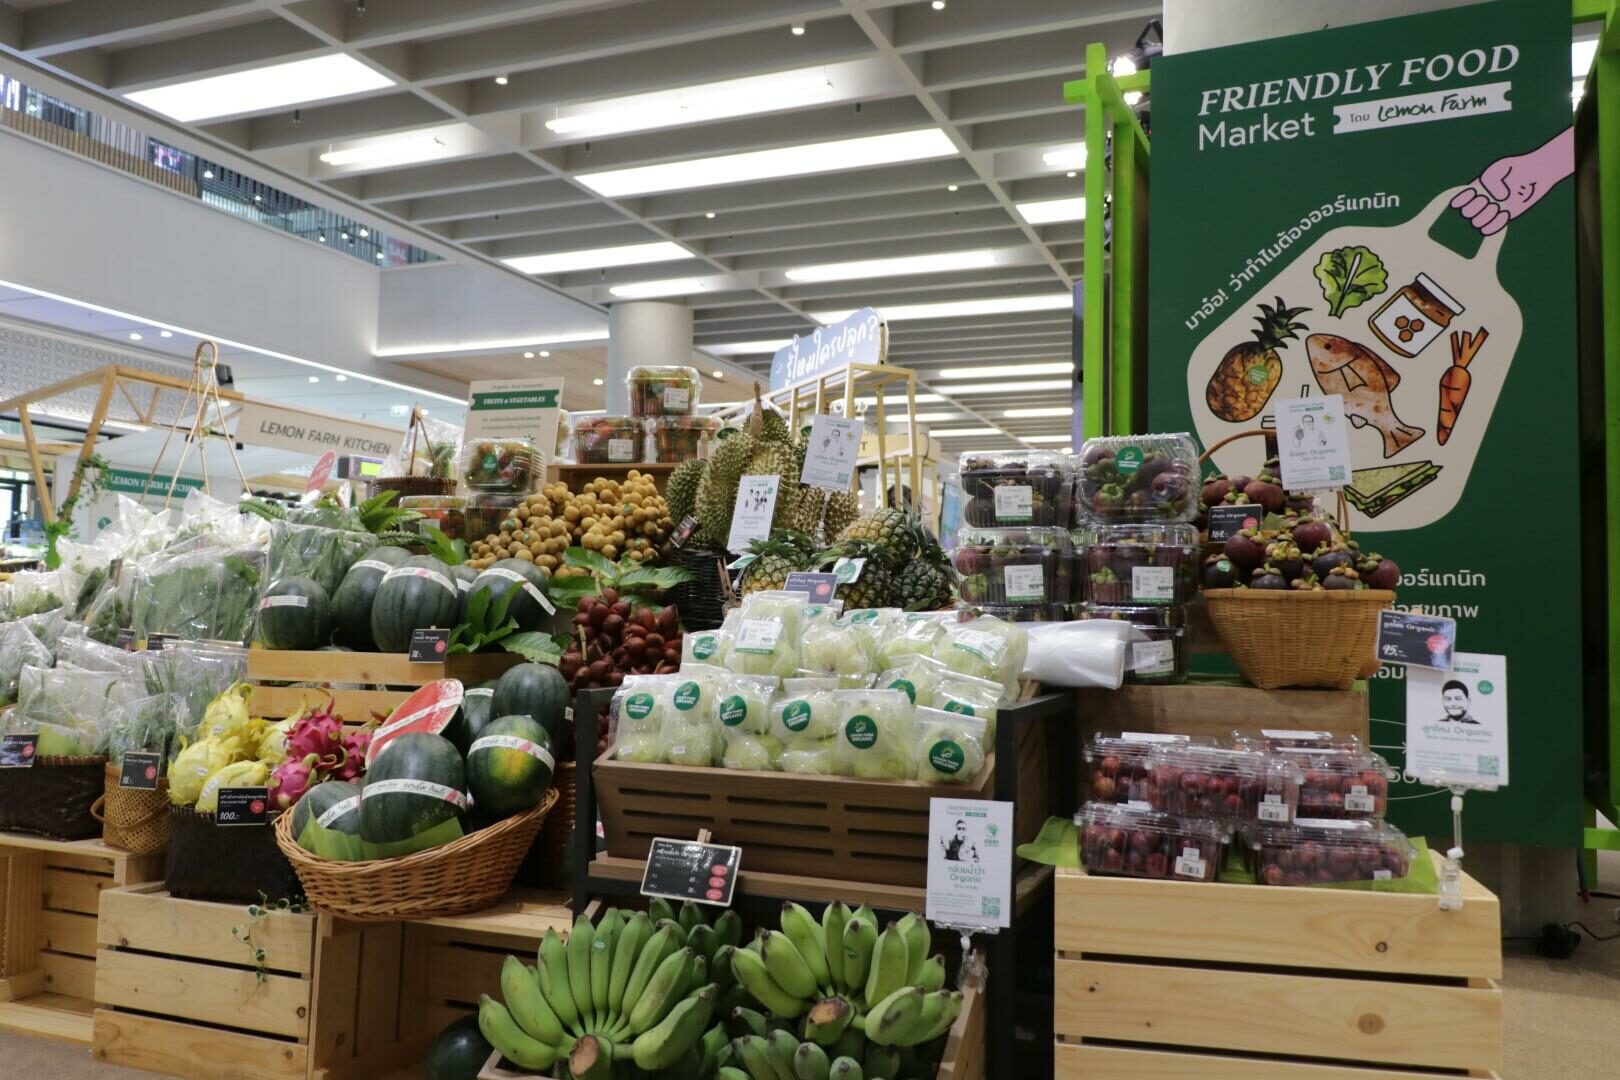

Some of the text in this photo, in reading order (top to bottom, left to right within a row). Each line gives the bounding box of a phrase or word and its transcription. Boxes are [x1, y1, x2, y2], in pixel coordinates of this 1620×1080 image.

[1198, 44, 1520, 116] FRIENDLY FOOD
[1350, 93, 1488, 124] โดย Lemon Farm
[1199, 112, 1316, 150] Market
[260, 420, 392, 455] LEMON FARM KITCHEN
[111, 472, 140, 487] LEMON
[1453, 726, 1493, 737] Organic
[950, 873, 984, 884] Organic
